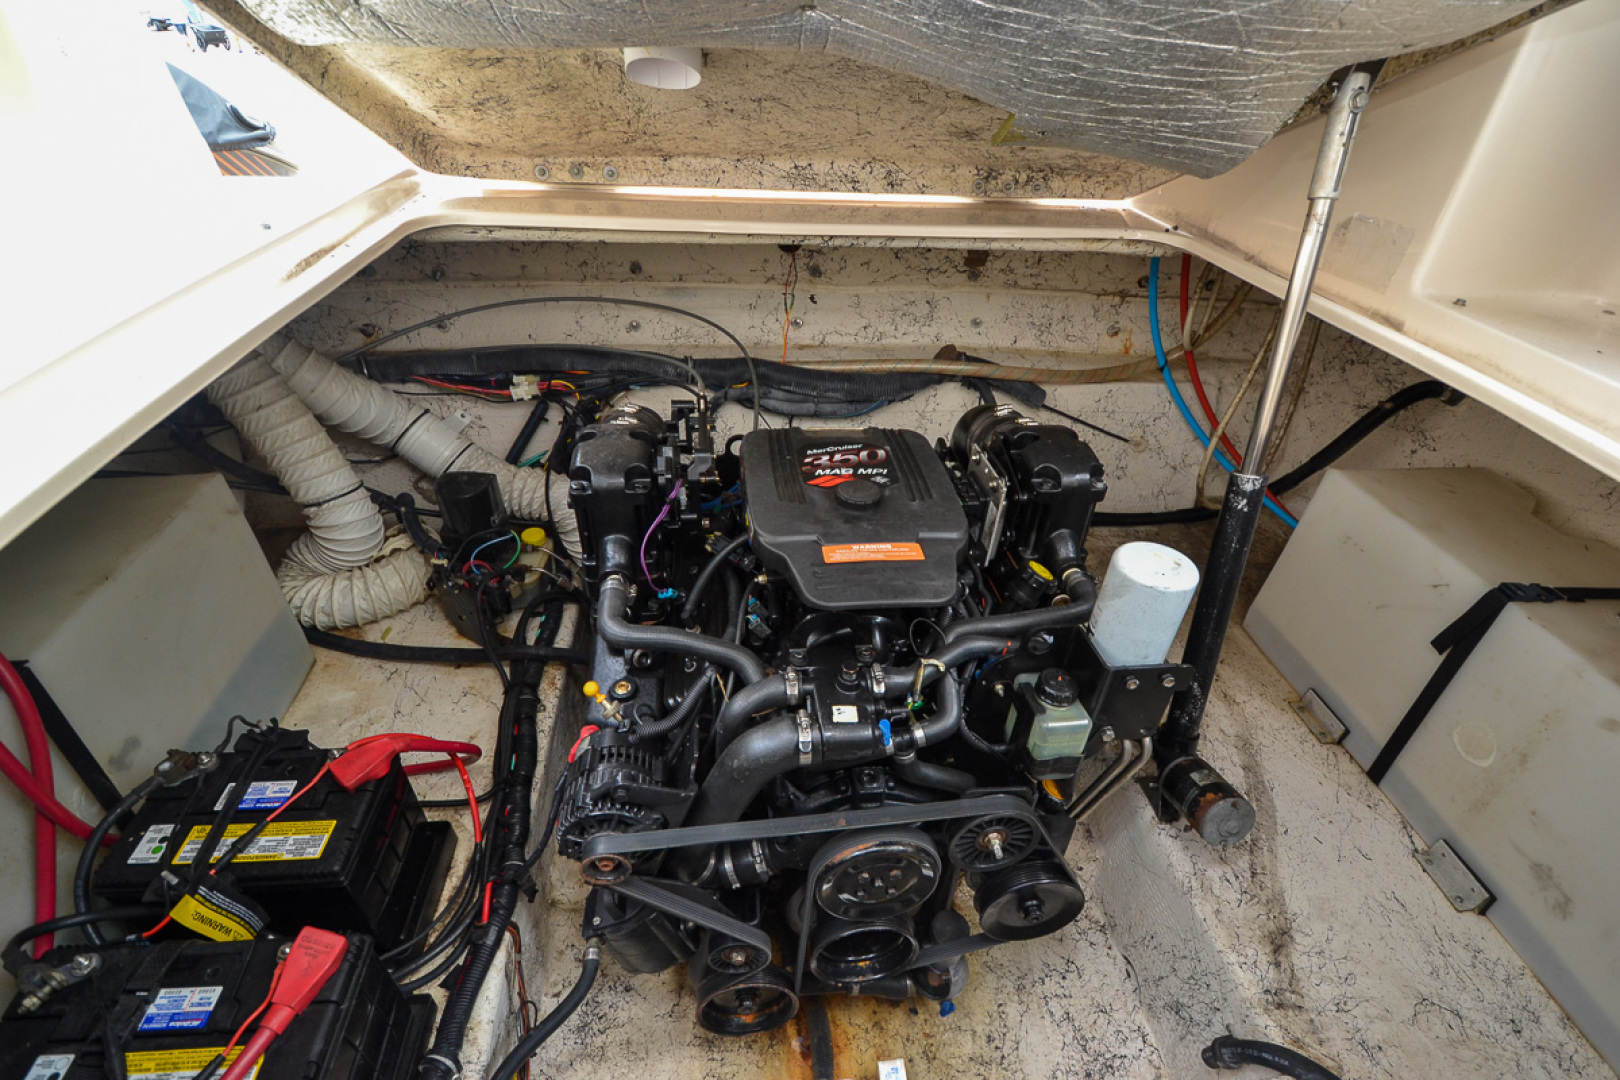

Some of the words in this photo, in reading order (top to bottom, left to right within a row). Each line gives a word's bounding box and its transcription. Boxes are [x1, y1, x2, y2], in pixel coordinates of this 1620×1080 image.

[807, 444, 863, 455] MerCruiser
[802, 448, 887, 472] 350
[857, 467, 888, 475] MPI
